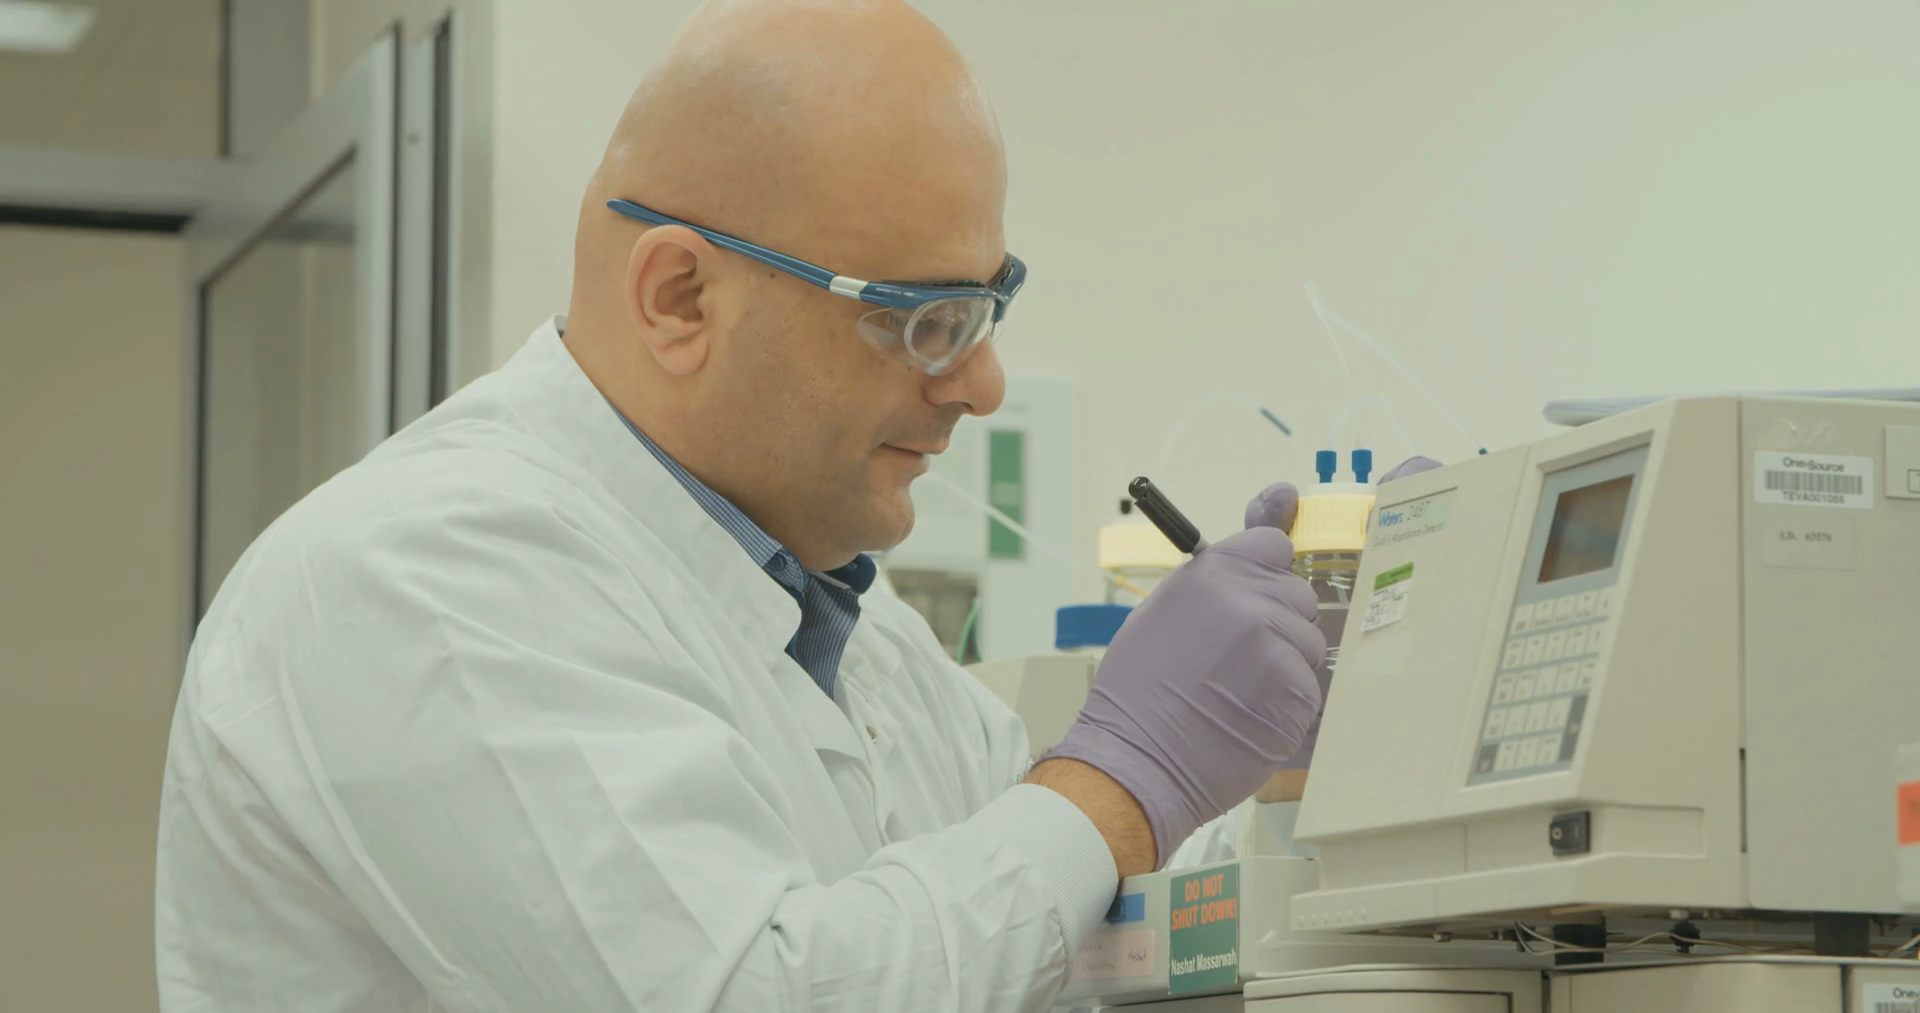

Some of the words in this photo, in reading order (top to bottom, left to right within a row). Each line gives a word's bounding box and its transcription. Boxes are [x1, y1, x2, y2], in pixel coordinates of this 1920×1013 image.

[1782, 456, 1845, 473] One-Source
[1185, 880, 1201, 903] DO
[1202, 873, 1225, 898] NOT
[1171, 906, 1200, 931] SHUT
[1201, 897, 1237, 924] DOWN!
[1171, 957, 1196, 977] Nashat
[1196, 948, 1237, 973] Massarwah
